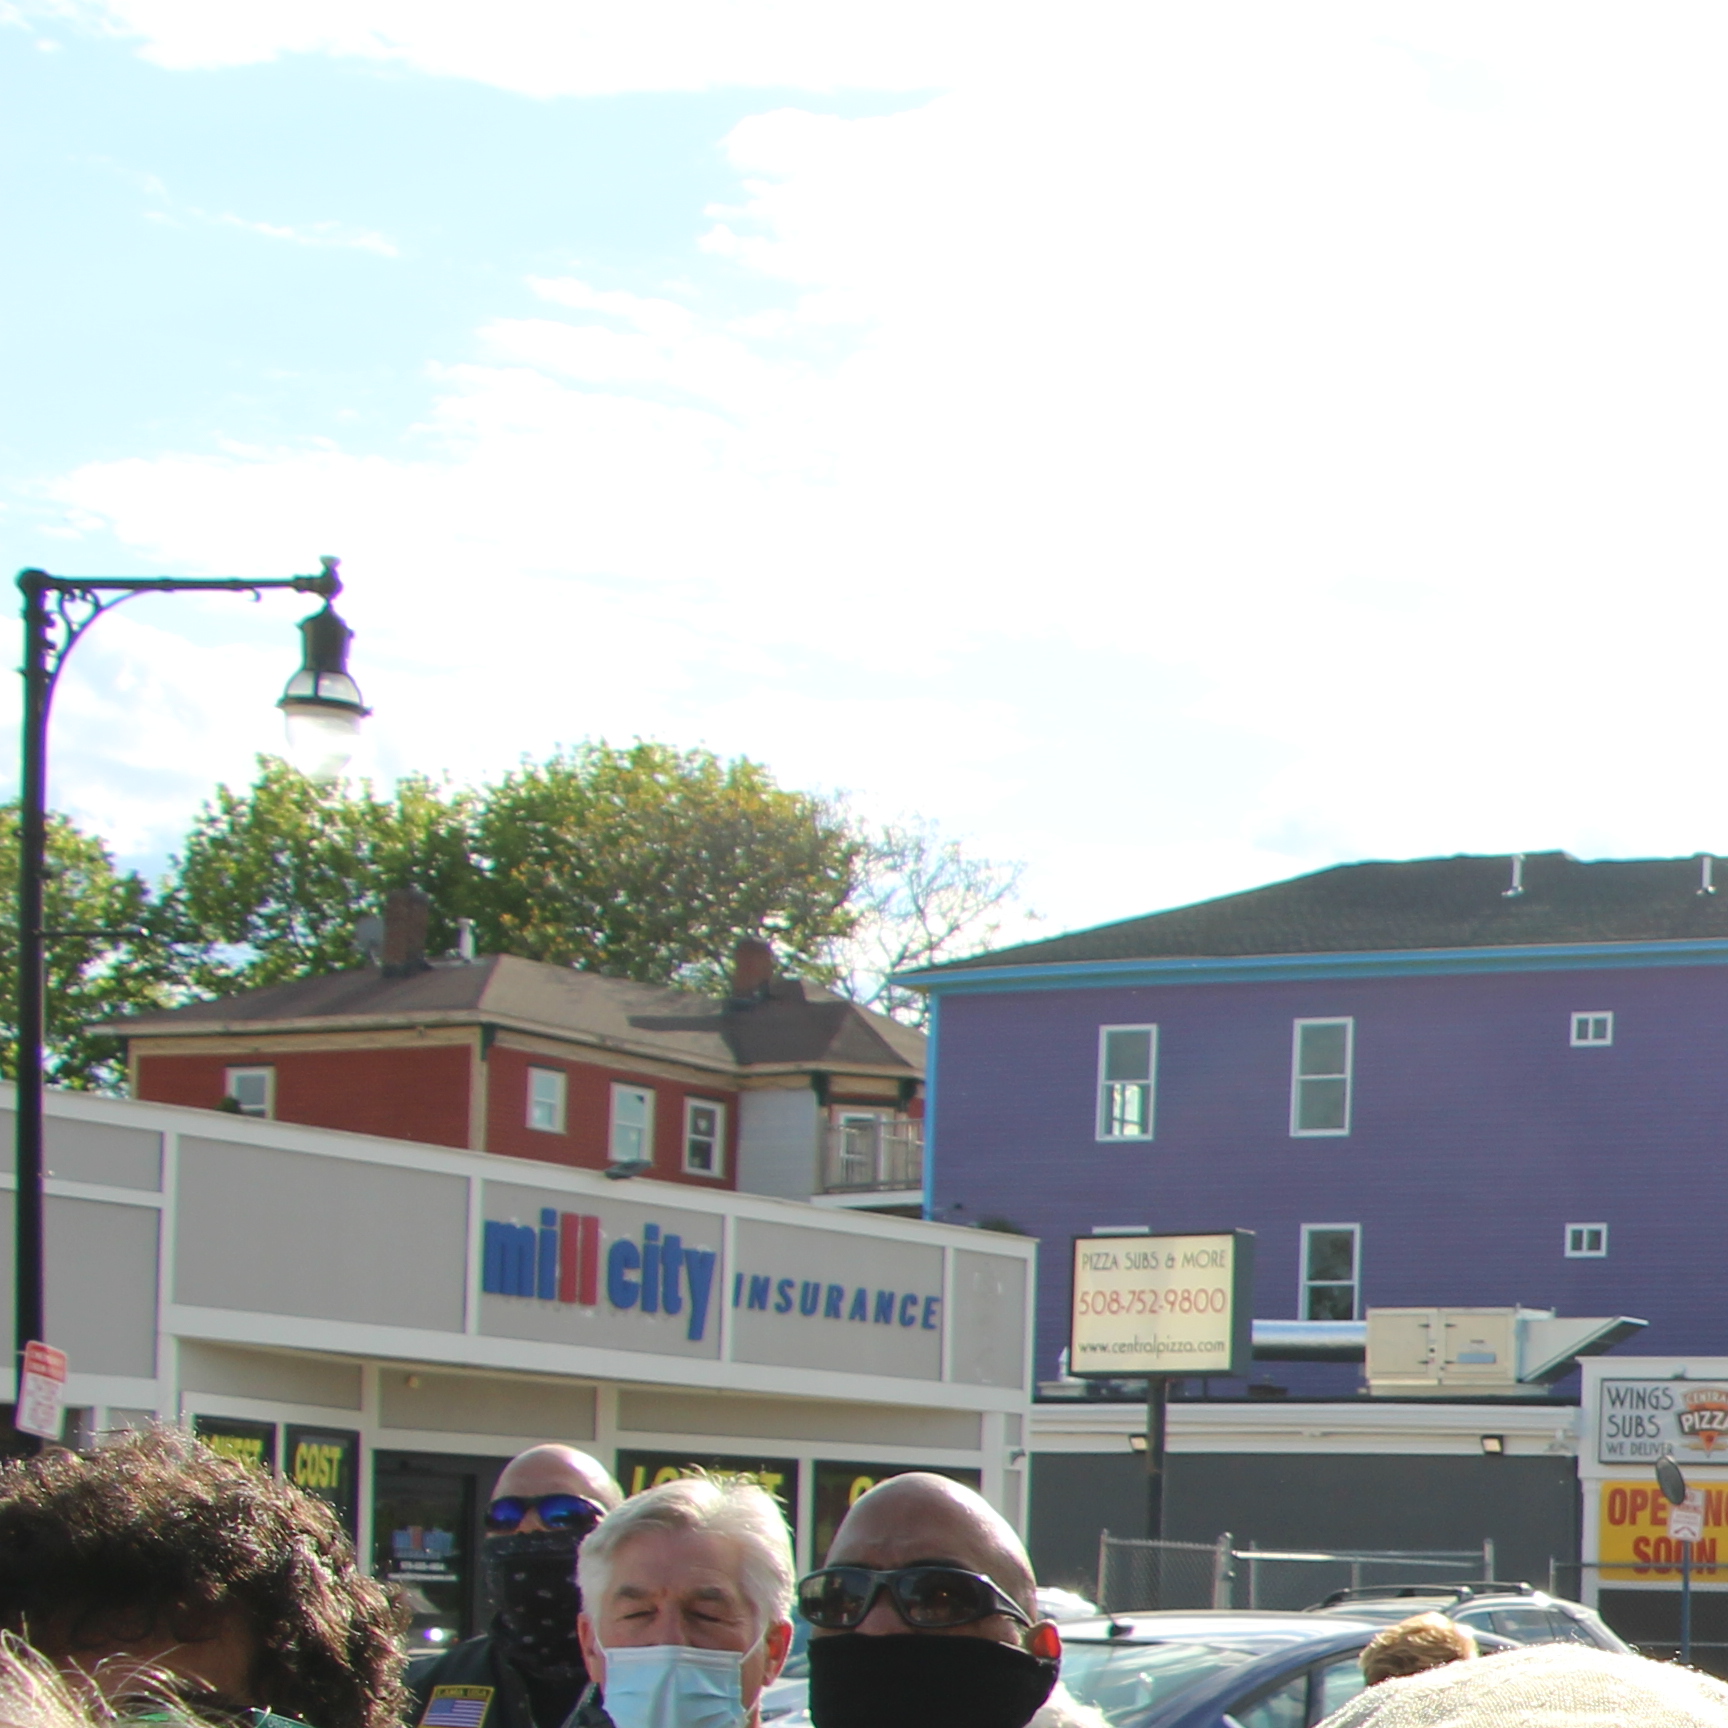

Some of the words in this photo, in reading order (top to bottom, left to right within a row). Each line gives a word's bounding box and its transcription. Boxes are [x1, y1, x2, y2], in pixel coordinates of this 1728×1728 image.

[1081, 1252, 1118, 1270] PIZZA
[1124, 1251, 1159, 1270] SUBS
[1165, 1252, 1176, 1269] &
[1181, 1250, 1226, 1268] MORE
[482, 1207, 599, 1306] mill
[607, 1222, 717, 1341] city
[732, 1272, 942, 1330] INSURANCE
[1078, 1287, 1226, 1315] 508-752-9800
[1078, 1333, 1225, 1358] www.centralpizza.com
[1607, 1386, 1674, 1411] WINGS
[1606, 1414, 1660, 1438] SUBS
[1606, 1442, 1624, 1455] WE
[1630, 1442, 1674, 1456] DELIVER
[295, 1442, 342, 1488] COST
